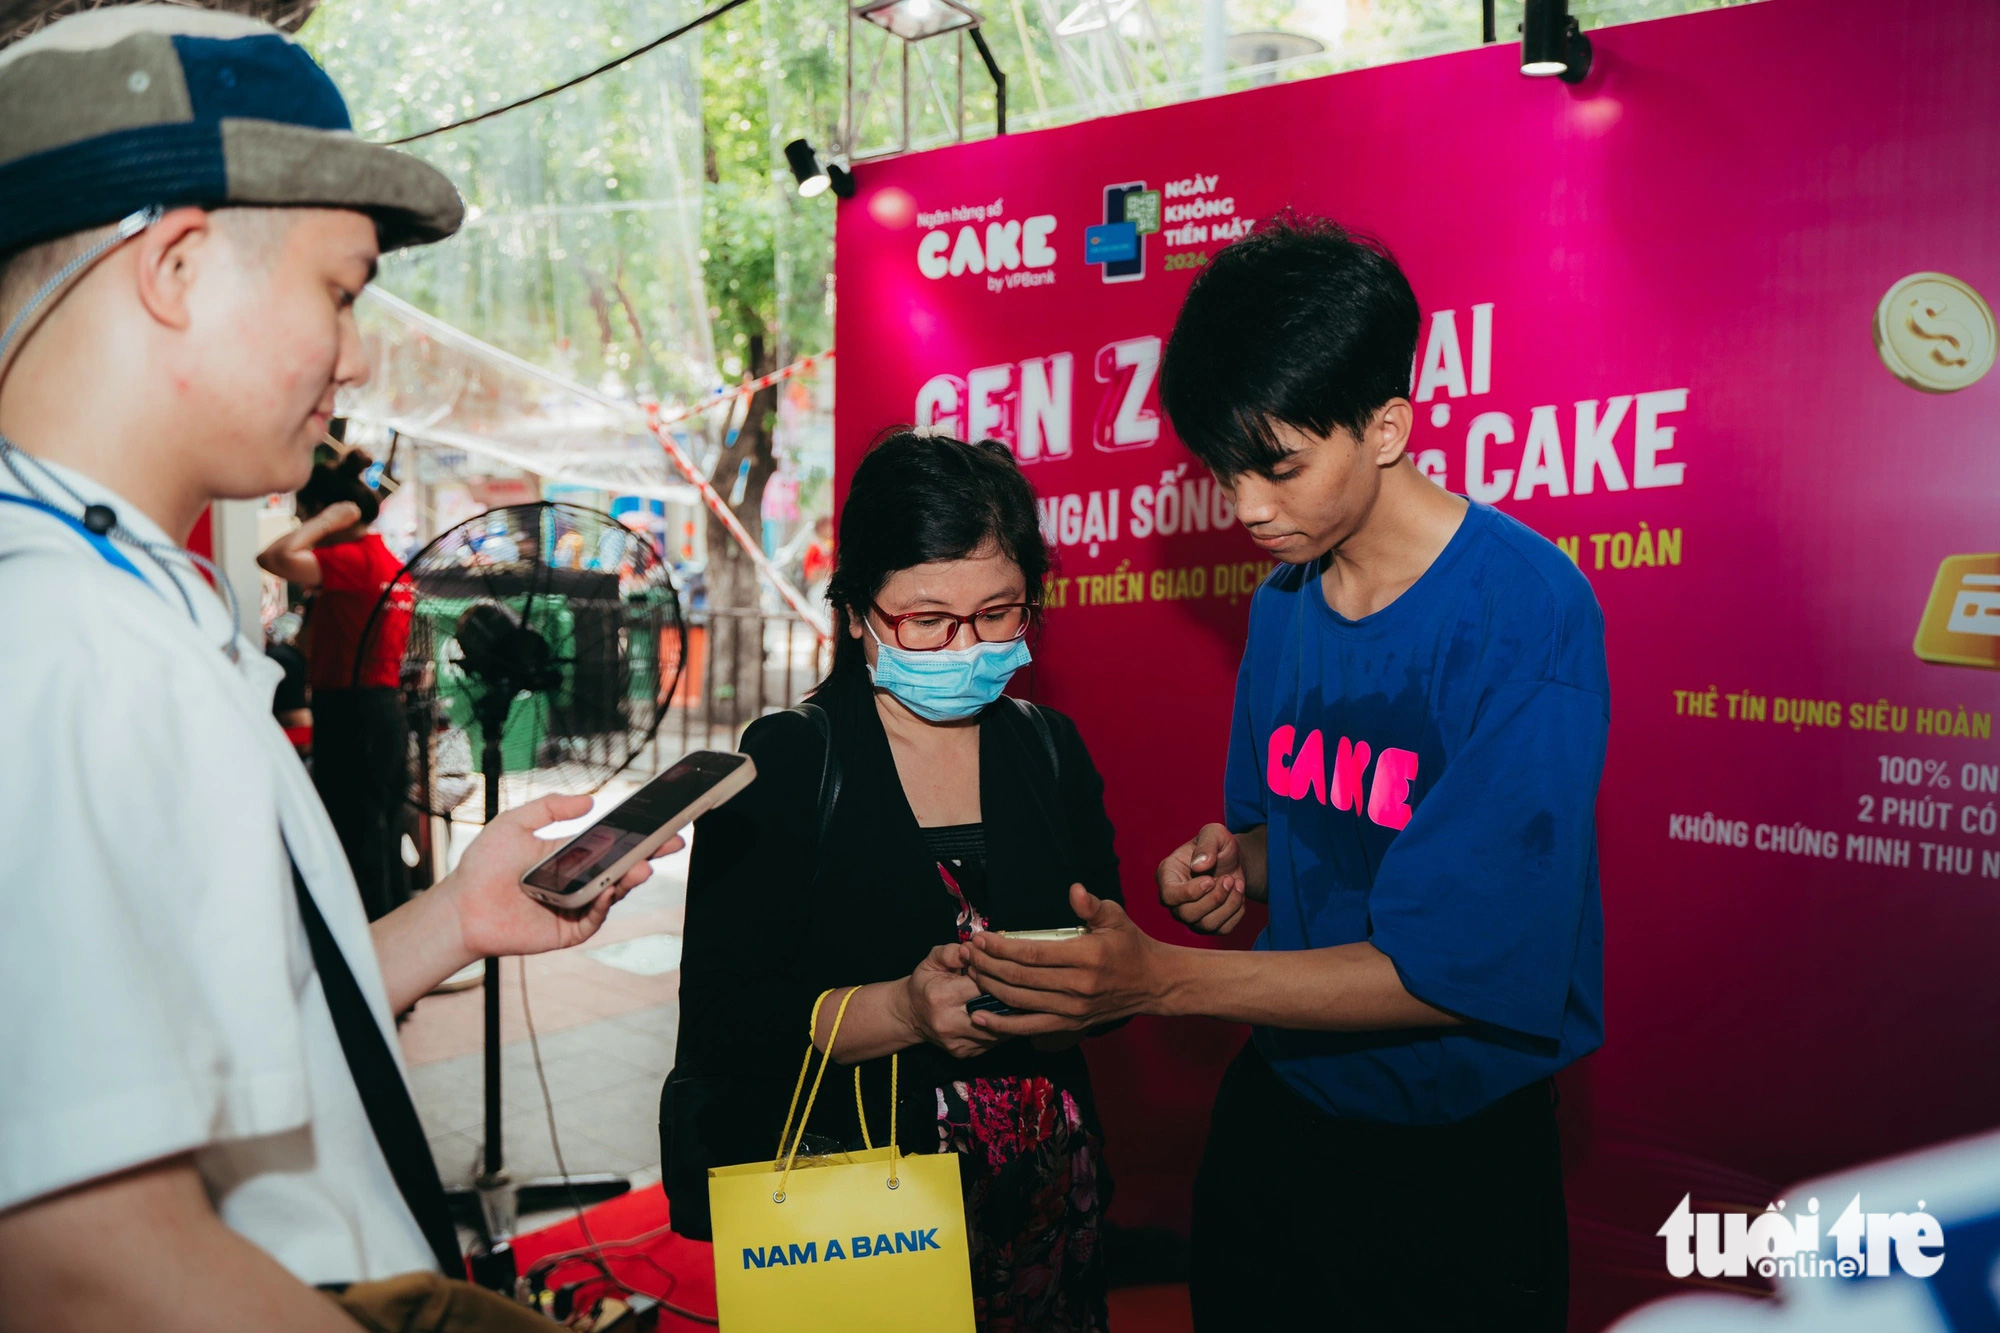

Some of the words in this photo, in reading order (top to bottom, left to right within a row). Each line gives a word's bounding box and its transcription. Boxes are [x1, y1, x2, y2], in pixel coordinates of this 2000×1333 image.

[1164, 173, 1219, 199] NGÀY
[1164, 196, 1235, 223] KHÔNG
[917, 210, 951, 230] Ngân
[952, 205, 985, 222] hàng
[986, 197, 1004, 218] số
[917, 214, 1057, 280] CAKE
[987, 275, 1004, 293] by
[1004, 269, 1055, 289] VPBank
[915, 351, 1074, 466] GEN
[1094, 335, 1162, 452] Z
[1409, 302, 1495, 428] ẠI
[1130, 463, 1236, 538] SỐNG
[1465, 388, 1690, 504] CAKE
[1077, 559, 1143, 607] TRIỂN
[1150, 565, 1203, 600] GIAO
[1589, 521, 1682, 571] TOÀN
[1673, 684, 1719, 719] THẺ
[1725, 688, 1767, 723] TÍN
[1772, 697, 1842, 733] DỤNG
[1915, 705, 1992, 740] HOÀN
[1266, 724, 1419, 831] CAKE
[1877, 755, 1952, 789] 100%
[1857, 795, 1875, 823] 2
[1882, 794, 1954, 831] PHÚT
[1960, 801, 1998, 836] CÓ
[1668, 811, 1750, 848] KHÔNG
[1754, 822, 1840, 860] CHỨNG
[1845, 833, 1911, 869] MINH
[1919, 841, 1974, 876] THU
[742, 1241, 818, 1270] NAM
[823, 1239, 847, 1262] A
[851, 1228, 942, 1259] BANK
